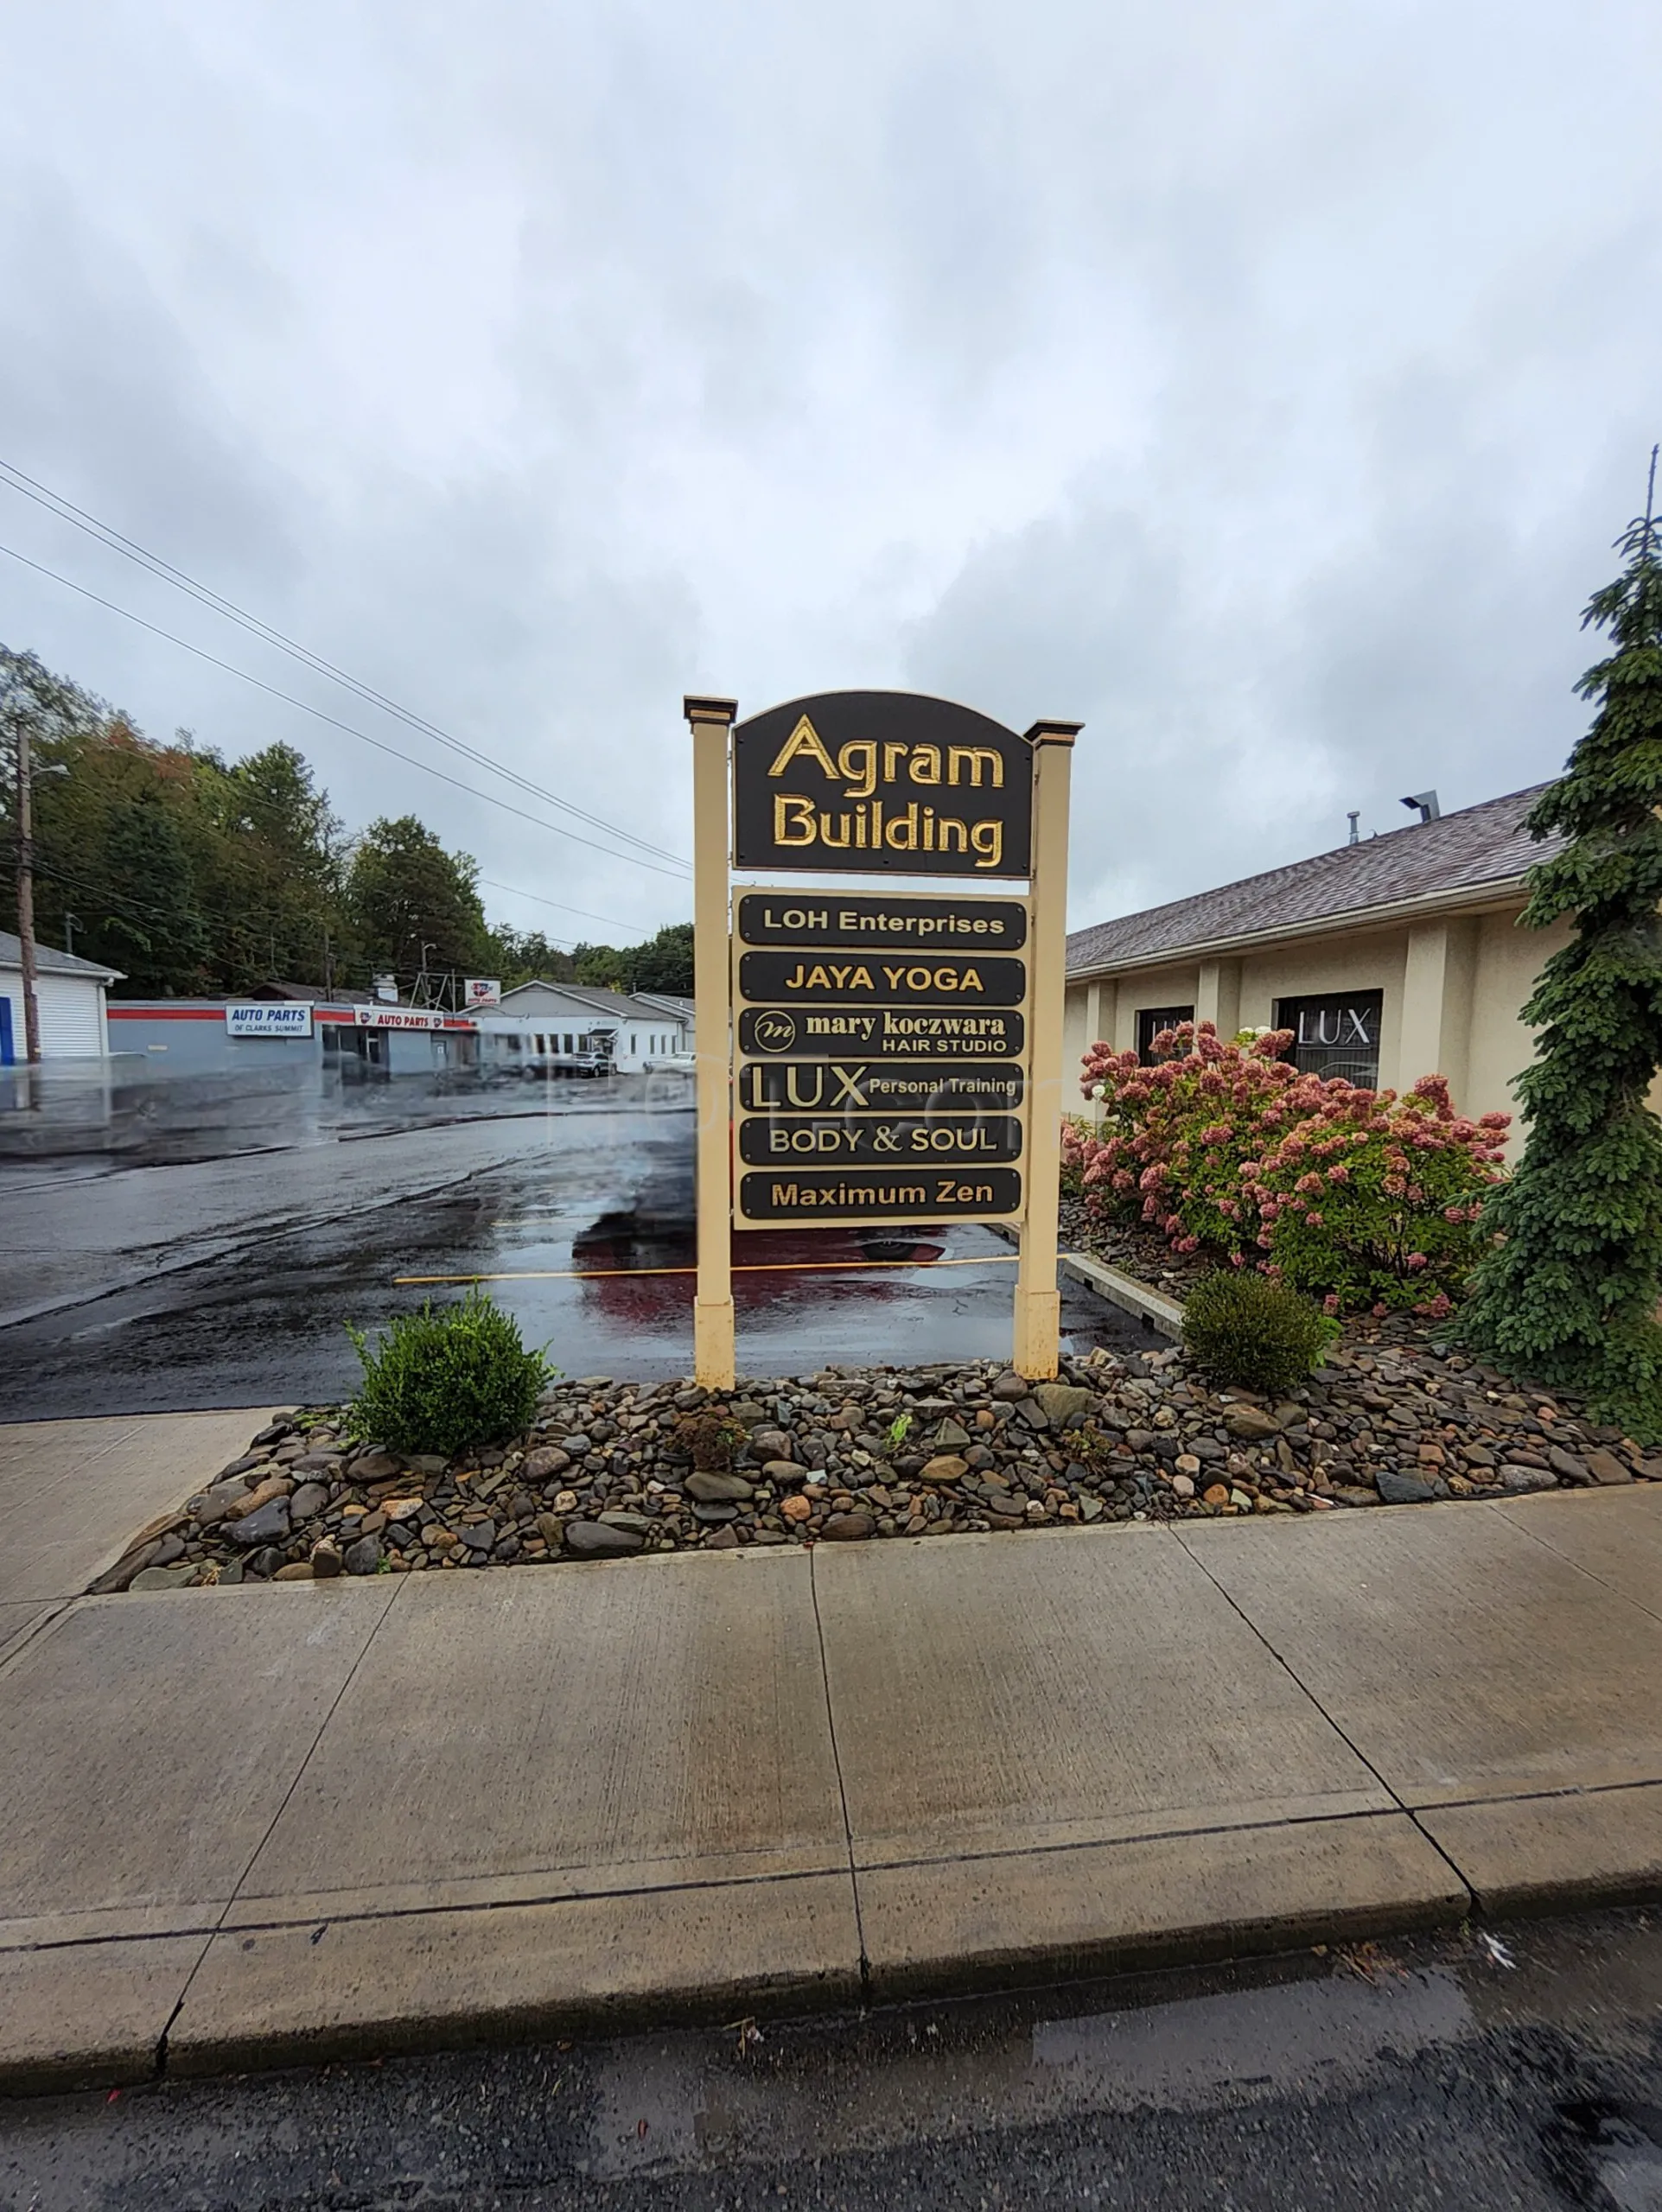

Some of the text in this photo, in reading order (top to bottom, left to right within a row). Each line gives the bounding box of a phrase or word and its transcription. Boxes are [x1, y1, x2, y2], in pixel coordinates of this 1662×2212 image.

[767, 713, 1005, 798] Agram
[773, 792, 1004, 868] Building
[763, 908, 1006, 937] LOH Enterprises
[785, 963, 985, 993] JAYA YOGA
[232, 1008, 306, 1022] AUTO PARTS
[245, 1024, 272, 1033] CLARKS
[274, 1024, 304, 1033] SUMMIT
[377, 1014, 402, 1026] AUTO
[404, 1015, 429, 1027] PARTS
[806, 1011, 1006, 1041] mary koczwara
[1298, 1007, 1372, 1046] LUX
[882, 1039, 1008, 1053] HAIR STUDIO
[751, 1065, 1017, 1109] LUX Personal Training
[769, 1125, 998, 1153] BODY & SOUL
[770, 1180, 994, 1207] Maximum Zen
